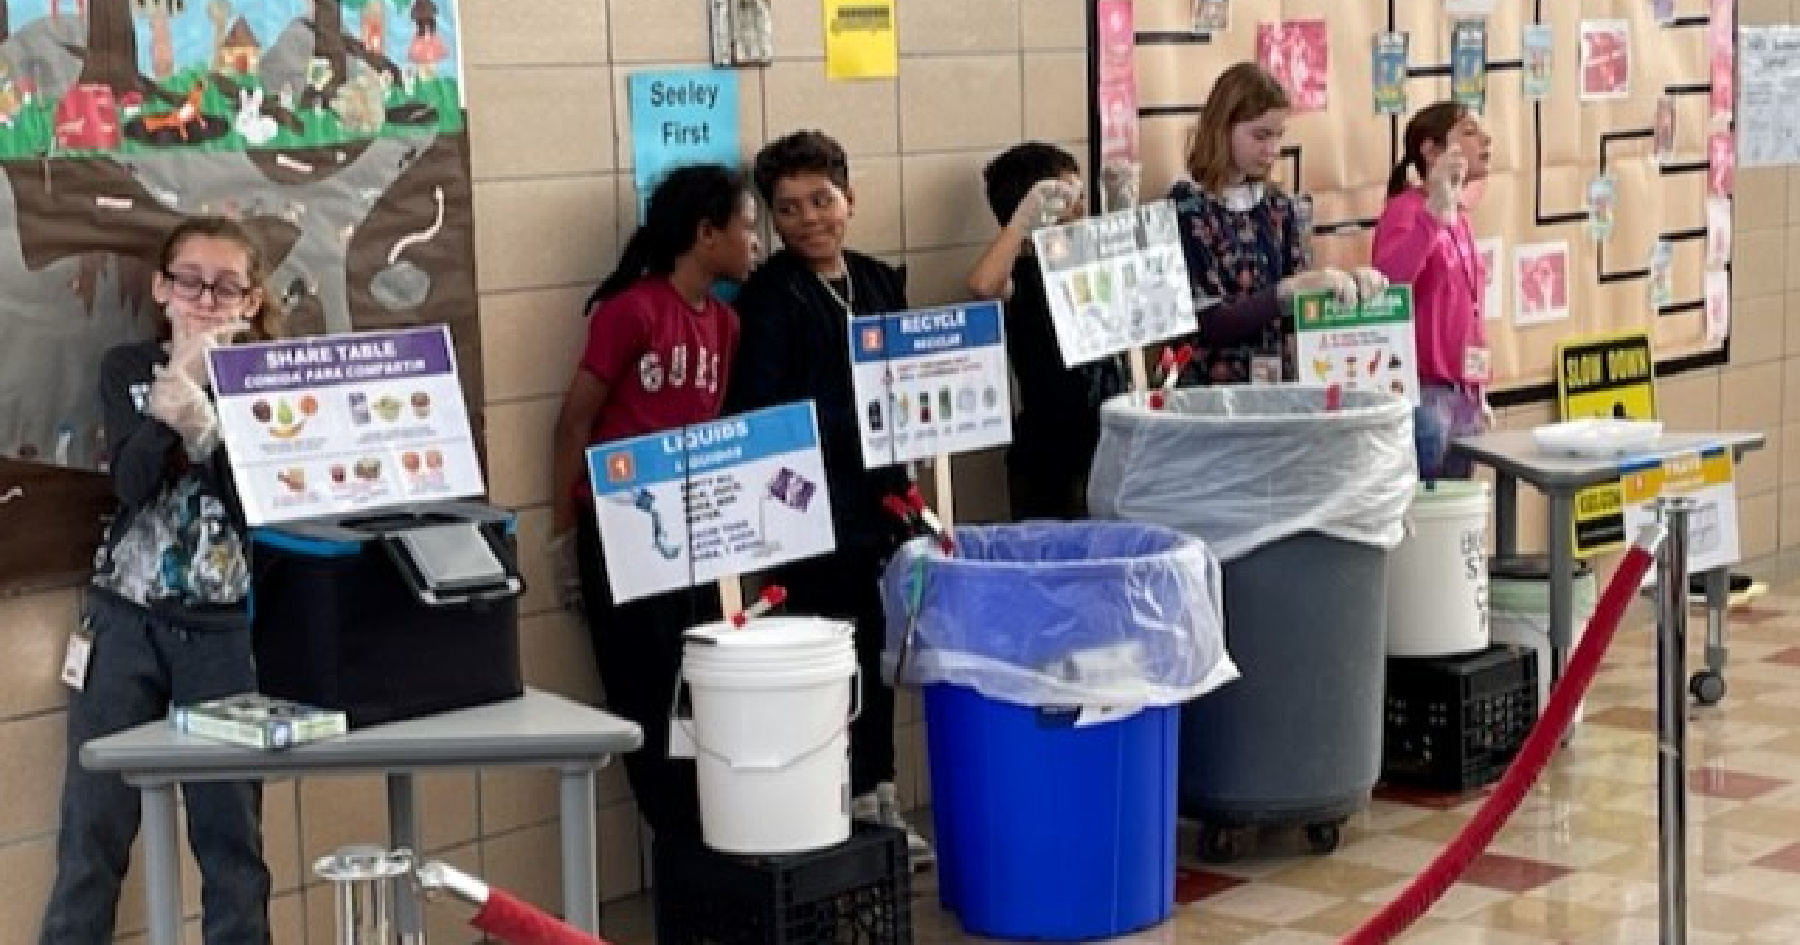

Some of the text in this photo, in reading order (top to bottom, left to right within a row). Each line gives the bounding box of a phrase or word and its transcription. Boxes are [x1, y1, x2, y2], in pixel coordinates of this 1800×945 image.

[649, 80, 719, 109] Seeley
[661, 120, 709, 147] First
[265, 340, 397, 369] SHARE TABLE
[662, 420, 749, 453] LIQUIDS
